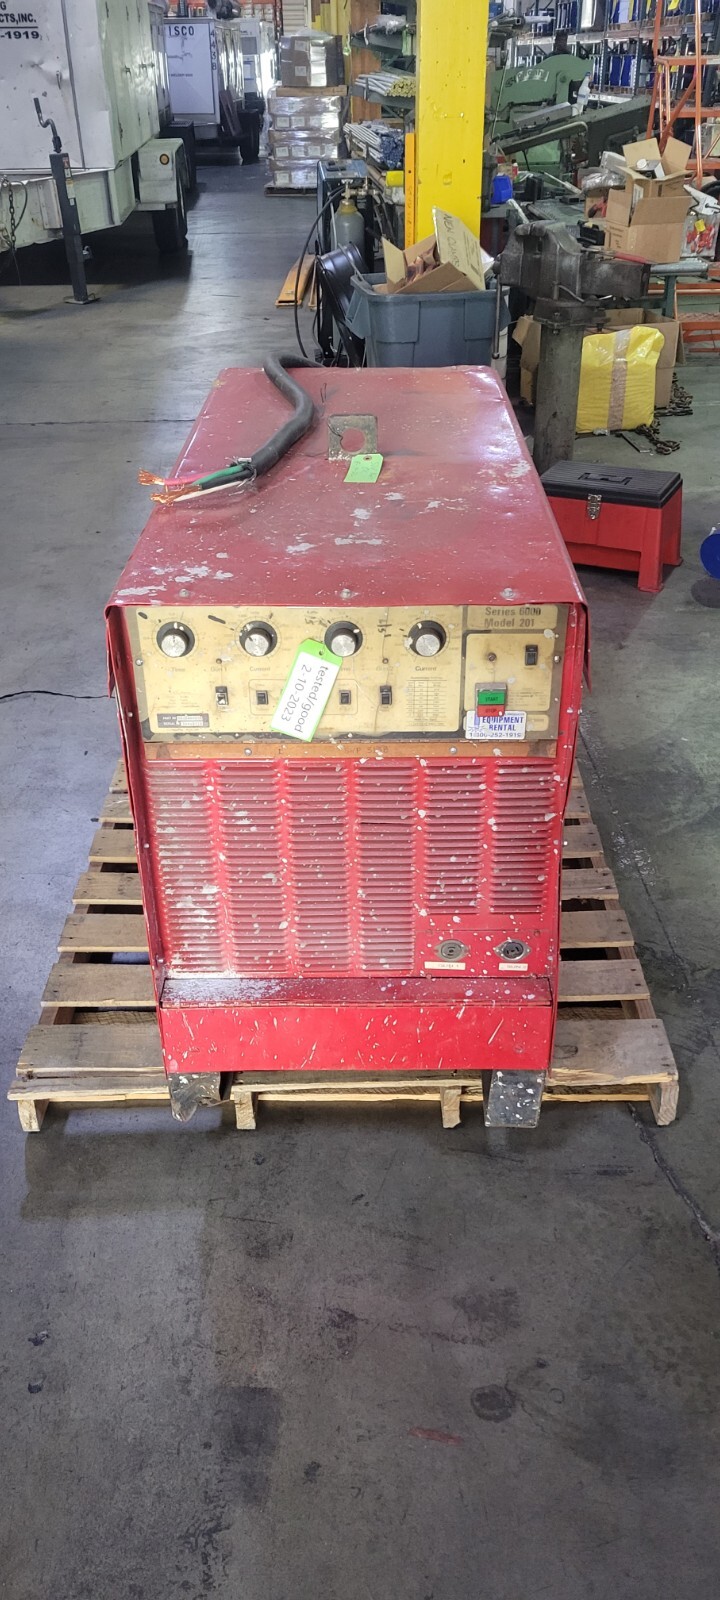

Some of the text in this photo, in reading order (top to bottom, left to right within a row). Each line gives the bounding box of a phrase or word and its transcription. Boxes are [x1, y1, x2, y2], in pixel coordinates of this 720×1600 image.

[485, 606, 541, 616] Series 6000
[484, 618, 535, 628] Model 201
[281, 664, 312, 722] 2-10-2023
[294, 665, 329, 733] tested/good
[482, 716, 524, 724] EQUIPMENT
